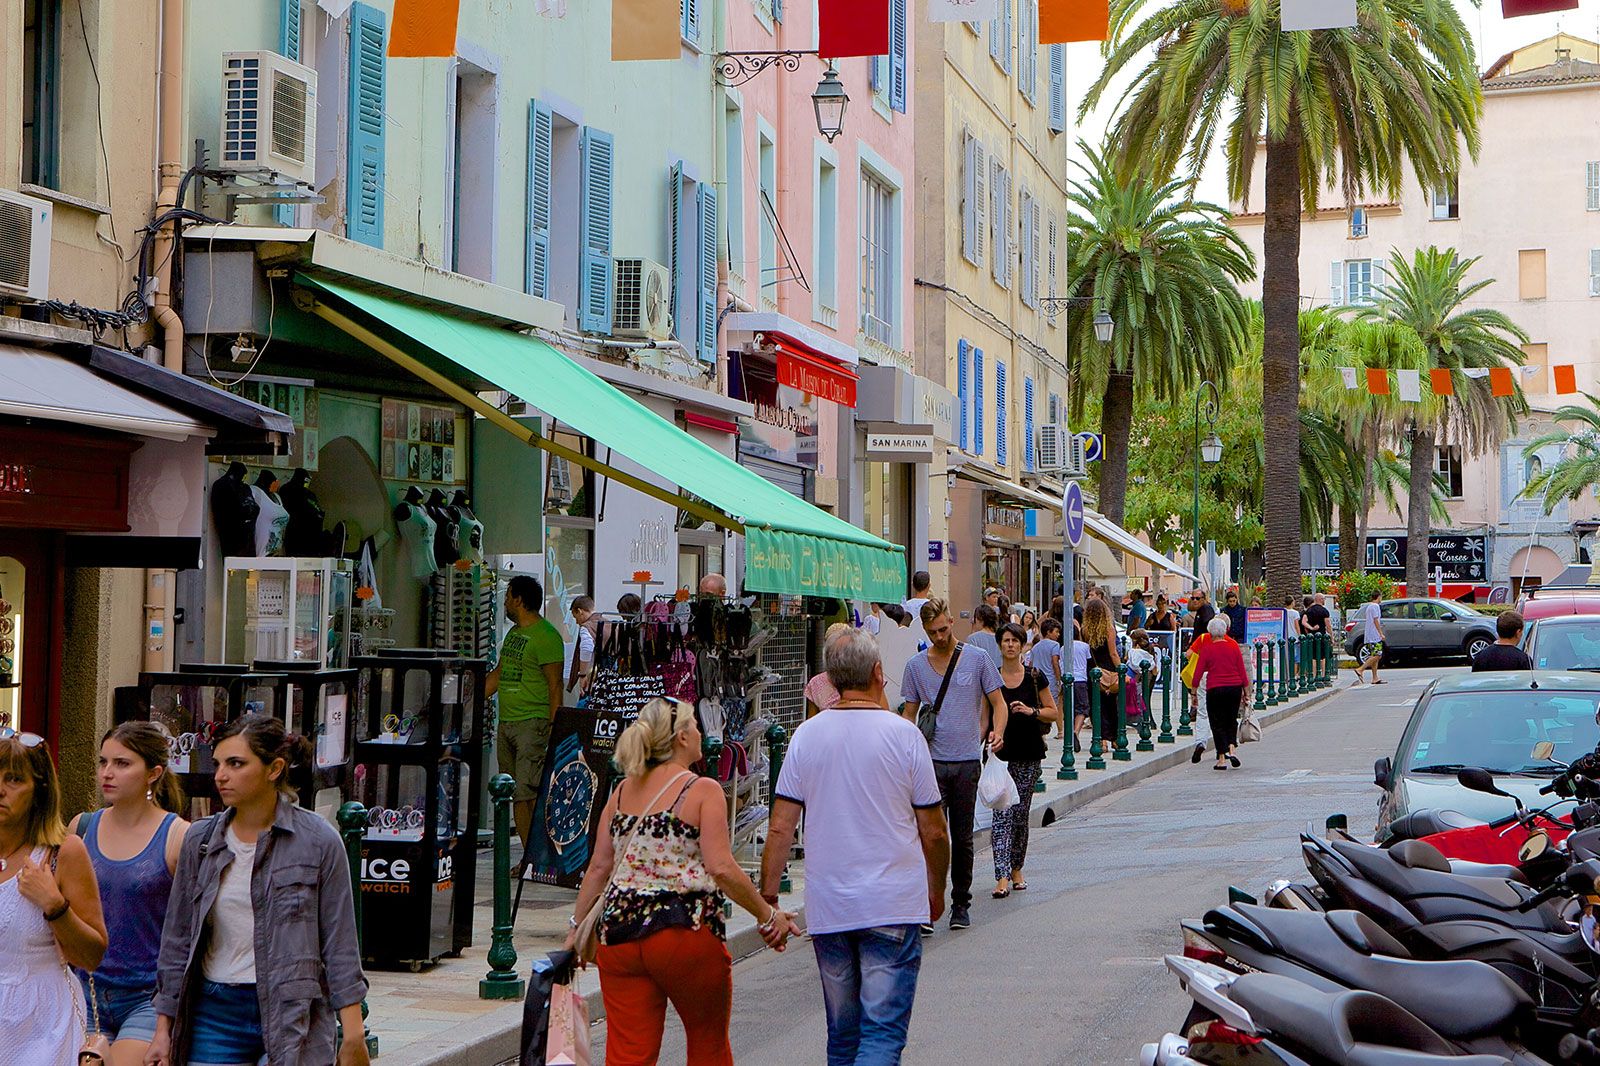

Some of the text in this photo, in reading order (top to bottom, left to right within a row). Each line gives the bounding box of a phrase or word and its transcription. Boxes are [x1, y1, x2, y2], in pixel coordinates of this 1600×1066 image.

[872, 439, 928, 448] SAN MARINA
[1428, 538, 1457, 549] oduits
[592, 738, 615, 748] watch
[360, 882, 410, 894] watch
